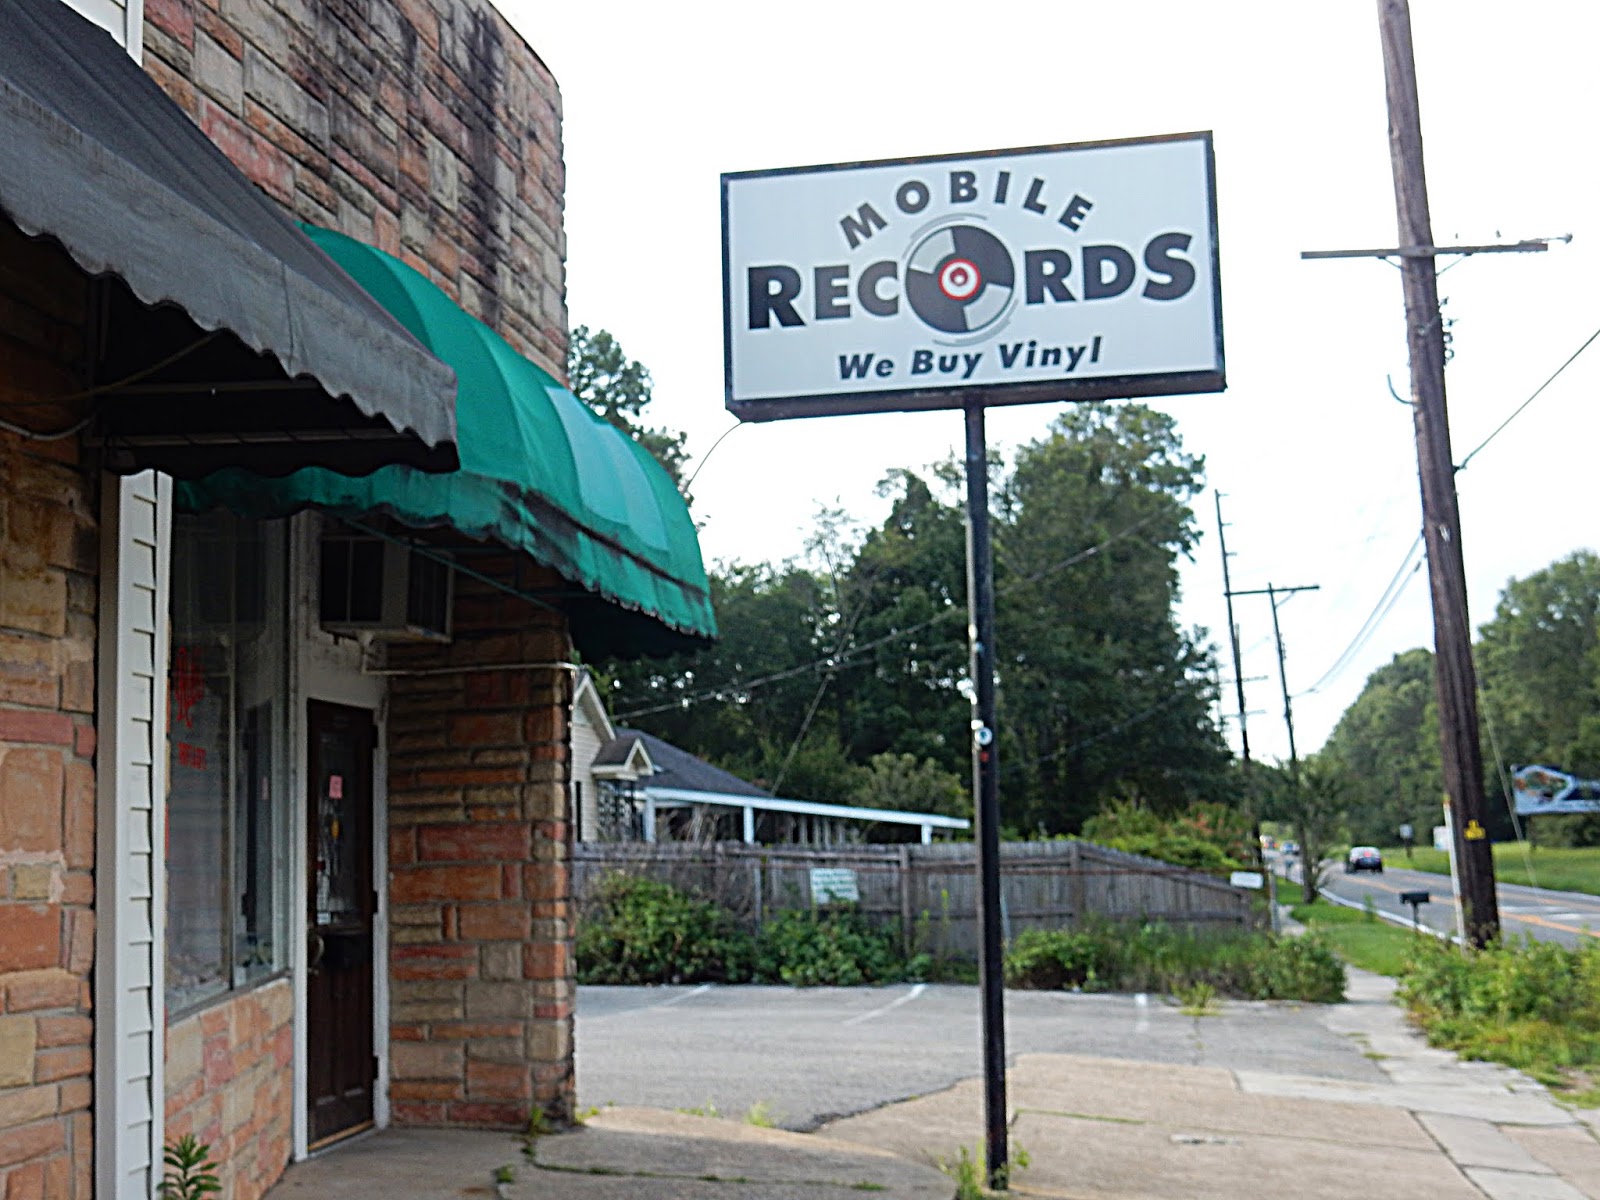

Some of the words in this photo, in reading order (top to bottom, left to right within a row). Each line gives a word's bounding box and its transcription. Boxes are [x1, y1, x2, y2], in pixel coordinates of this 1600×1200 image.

[840, 170, 1093, 250] MOBILE
[747, 232, 1197, 331] RECORDS
[839, 353, 895, 380] We
[910, 349, 984, 380] Buy
[998, 336, 1103, 373] Vinyl
